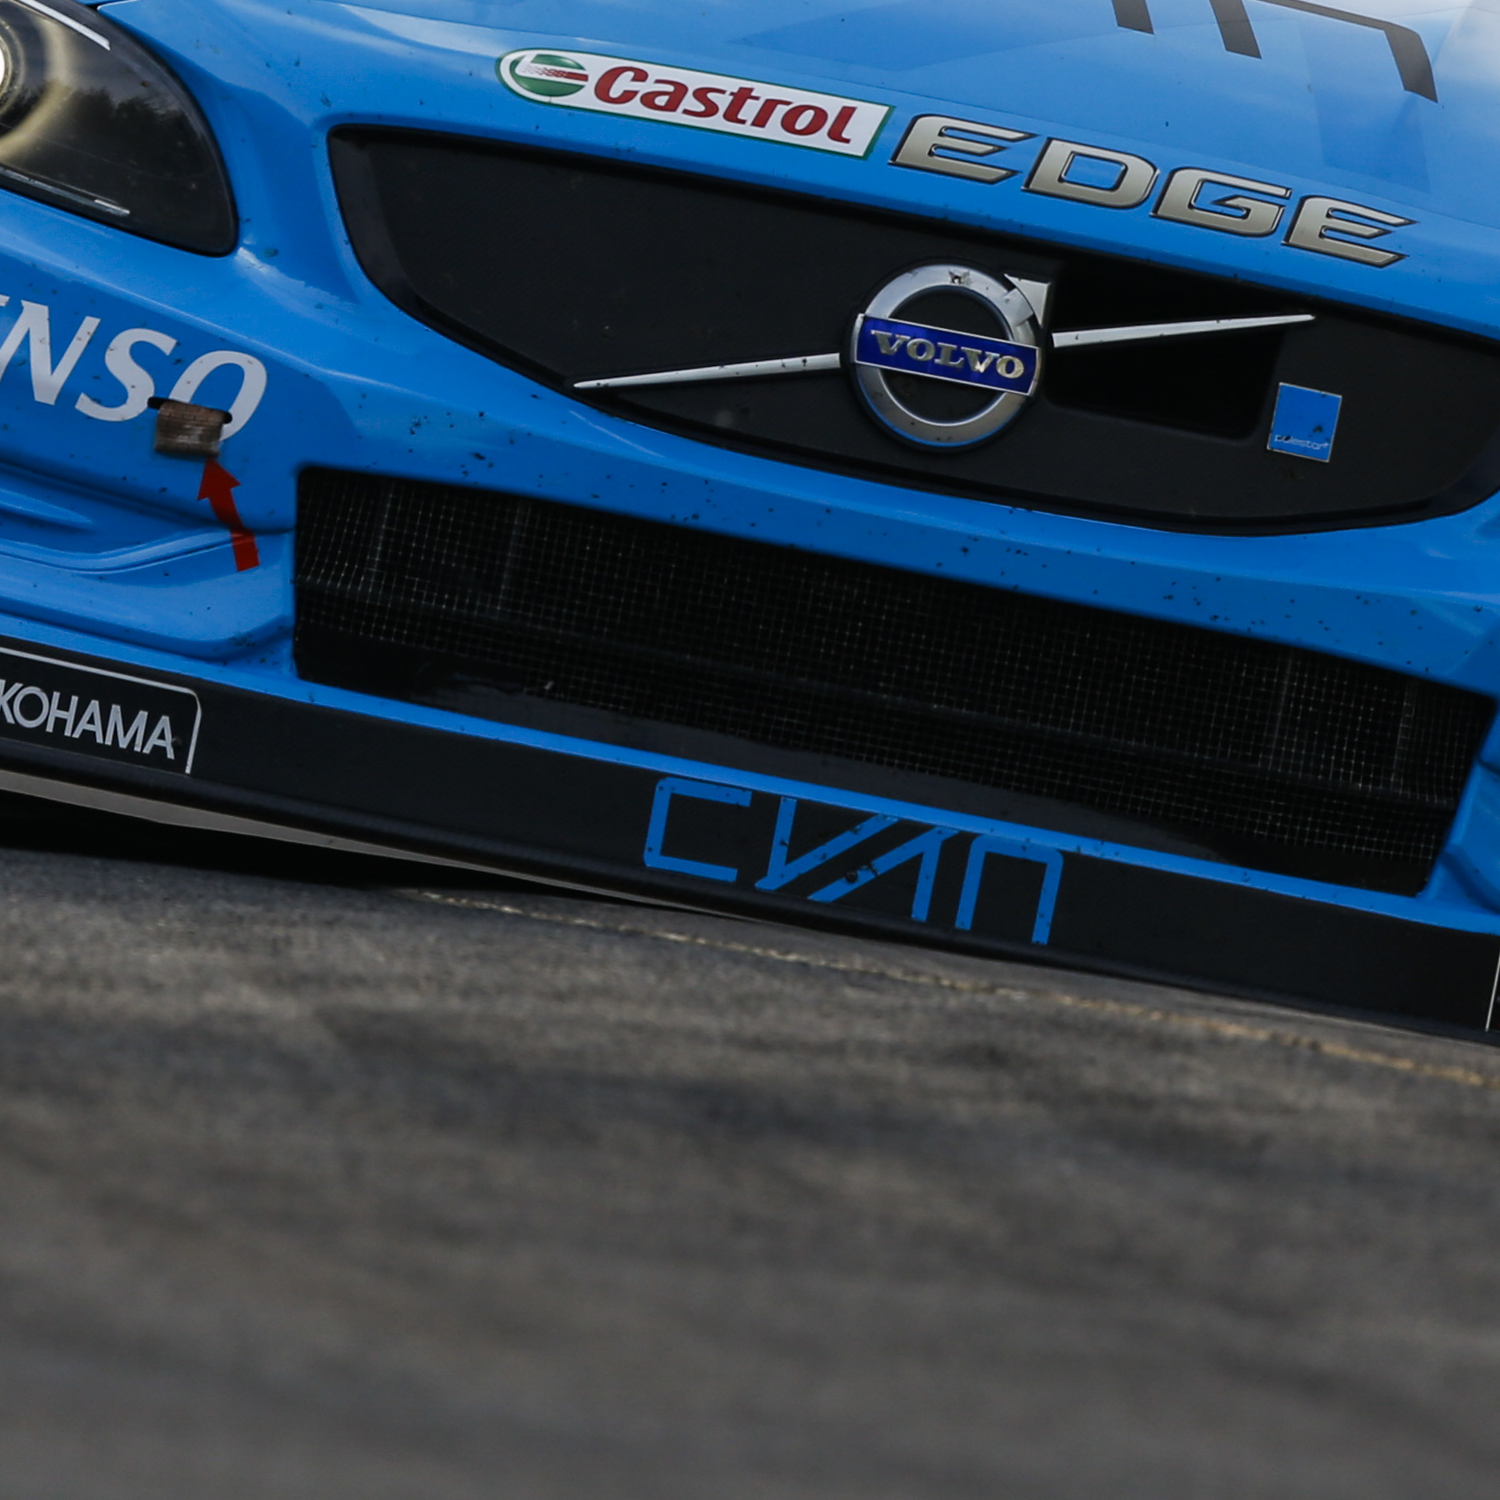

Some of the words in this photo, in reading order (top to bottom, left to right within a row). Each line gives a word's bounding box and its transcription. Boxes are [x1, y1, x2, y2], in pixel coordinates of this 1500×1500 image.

[594, 66, 855, 146] Castrol
[889, 113, 1419, 268] EDGE
[870, 329, 1025, 379] VOLVO
